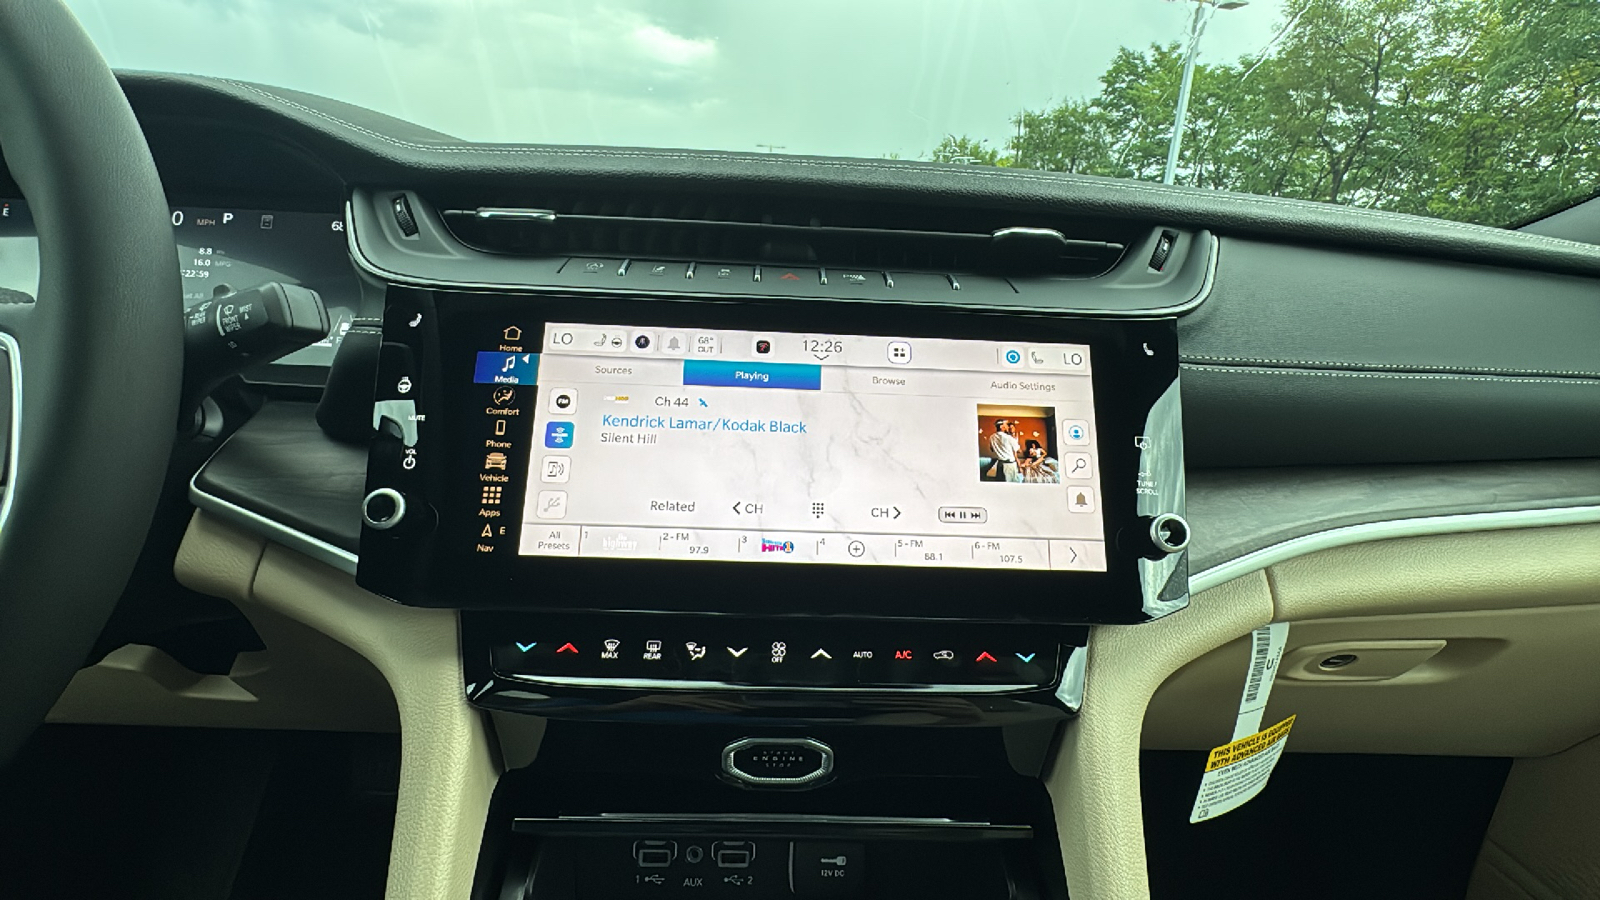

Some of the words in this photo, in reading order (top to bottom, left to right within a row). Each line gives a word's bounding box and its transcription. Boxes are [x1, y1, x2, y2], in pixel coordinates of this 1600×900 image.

[2, 207, 10, 217] E
[172, 211, 184, 226] 0
[196, 218, 216, 226] MPH
[222, 212, 234, 224] P
[198, 247, 213, 255] 8.8
[194, 258, 211, 267] 16.0
[553, 332, 573, 345] LO
[499, 344, 523, 353] Home
[698, 346, 714, 354] OUT
[803, 340, 843, 353] 12:26
[1063, 353, 1082, 366] LO
[595, 365, 633, 375] Sources
[494, 375, 519, 384] Media
[735, 371, 770, 382] Playing
[872, 376, 906, 386] Browse
[990, 381, 1018, 391] Audio
[1019, 381, 1056, 393] Settings
[655, 396, 671, 407] Ch
[673, 397, 689, 407] 44
[486, 407, 520, 416] Comfort
[602, 414, 665, 429] Kendrick
[669, 417, 765, 432] Lamar/Kodak
[770, 420, 807, 434] Black
[601, 432, 634, 444] Silent
[637, 433, 657, 445] Hill
[486, 439, 512, 449] Phone
[480, 473, 509, 483] Vehicle
[1136, 488, 1159, 496] SCROLL
[650, 500, 696, 512] Related
[744, 503, 764, 514] CH
[478, 508, 501, 518] Apps
[871, 507, 889, 518] CH
[499, 526, 506, 535] E
[549, 530, 561, 540] All
[742, 535, 747, 544] 3
[820, 538, 826, 546] 4
[476, 543, 494, 553] Nav
[538, 541, 570, 551] Presets
[689, 546, 709, 554] 97.9
[1000, 554, 1023, 564] 107.5
[643, 652, 662, 660] REAR
[853, 651, 873, 659] AUTO
[895, 650, 912, 660] A/C
[1214, 746, 1231, 759] THIS
[1233, 736, 1260, 752] VEHICLE
[1211, 756, 1231, 769] WITH
[1231, 742, 1267, 762] ADVANCED
[820, 869, 833, 877] 12V
[834, 869, 845, 877] DC
[635, 875, 640, 884] 1
[683, 877, 703, 887] AUX
[747, 876, 753, 885] 2
